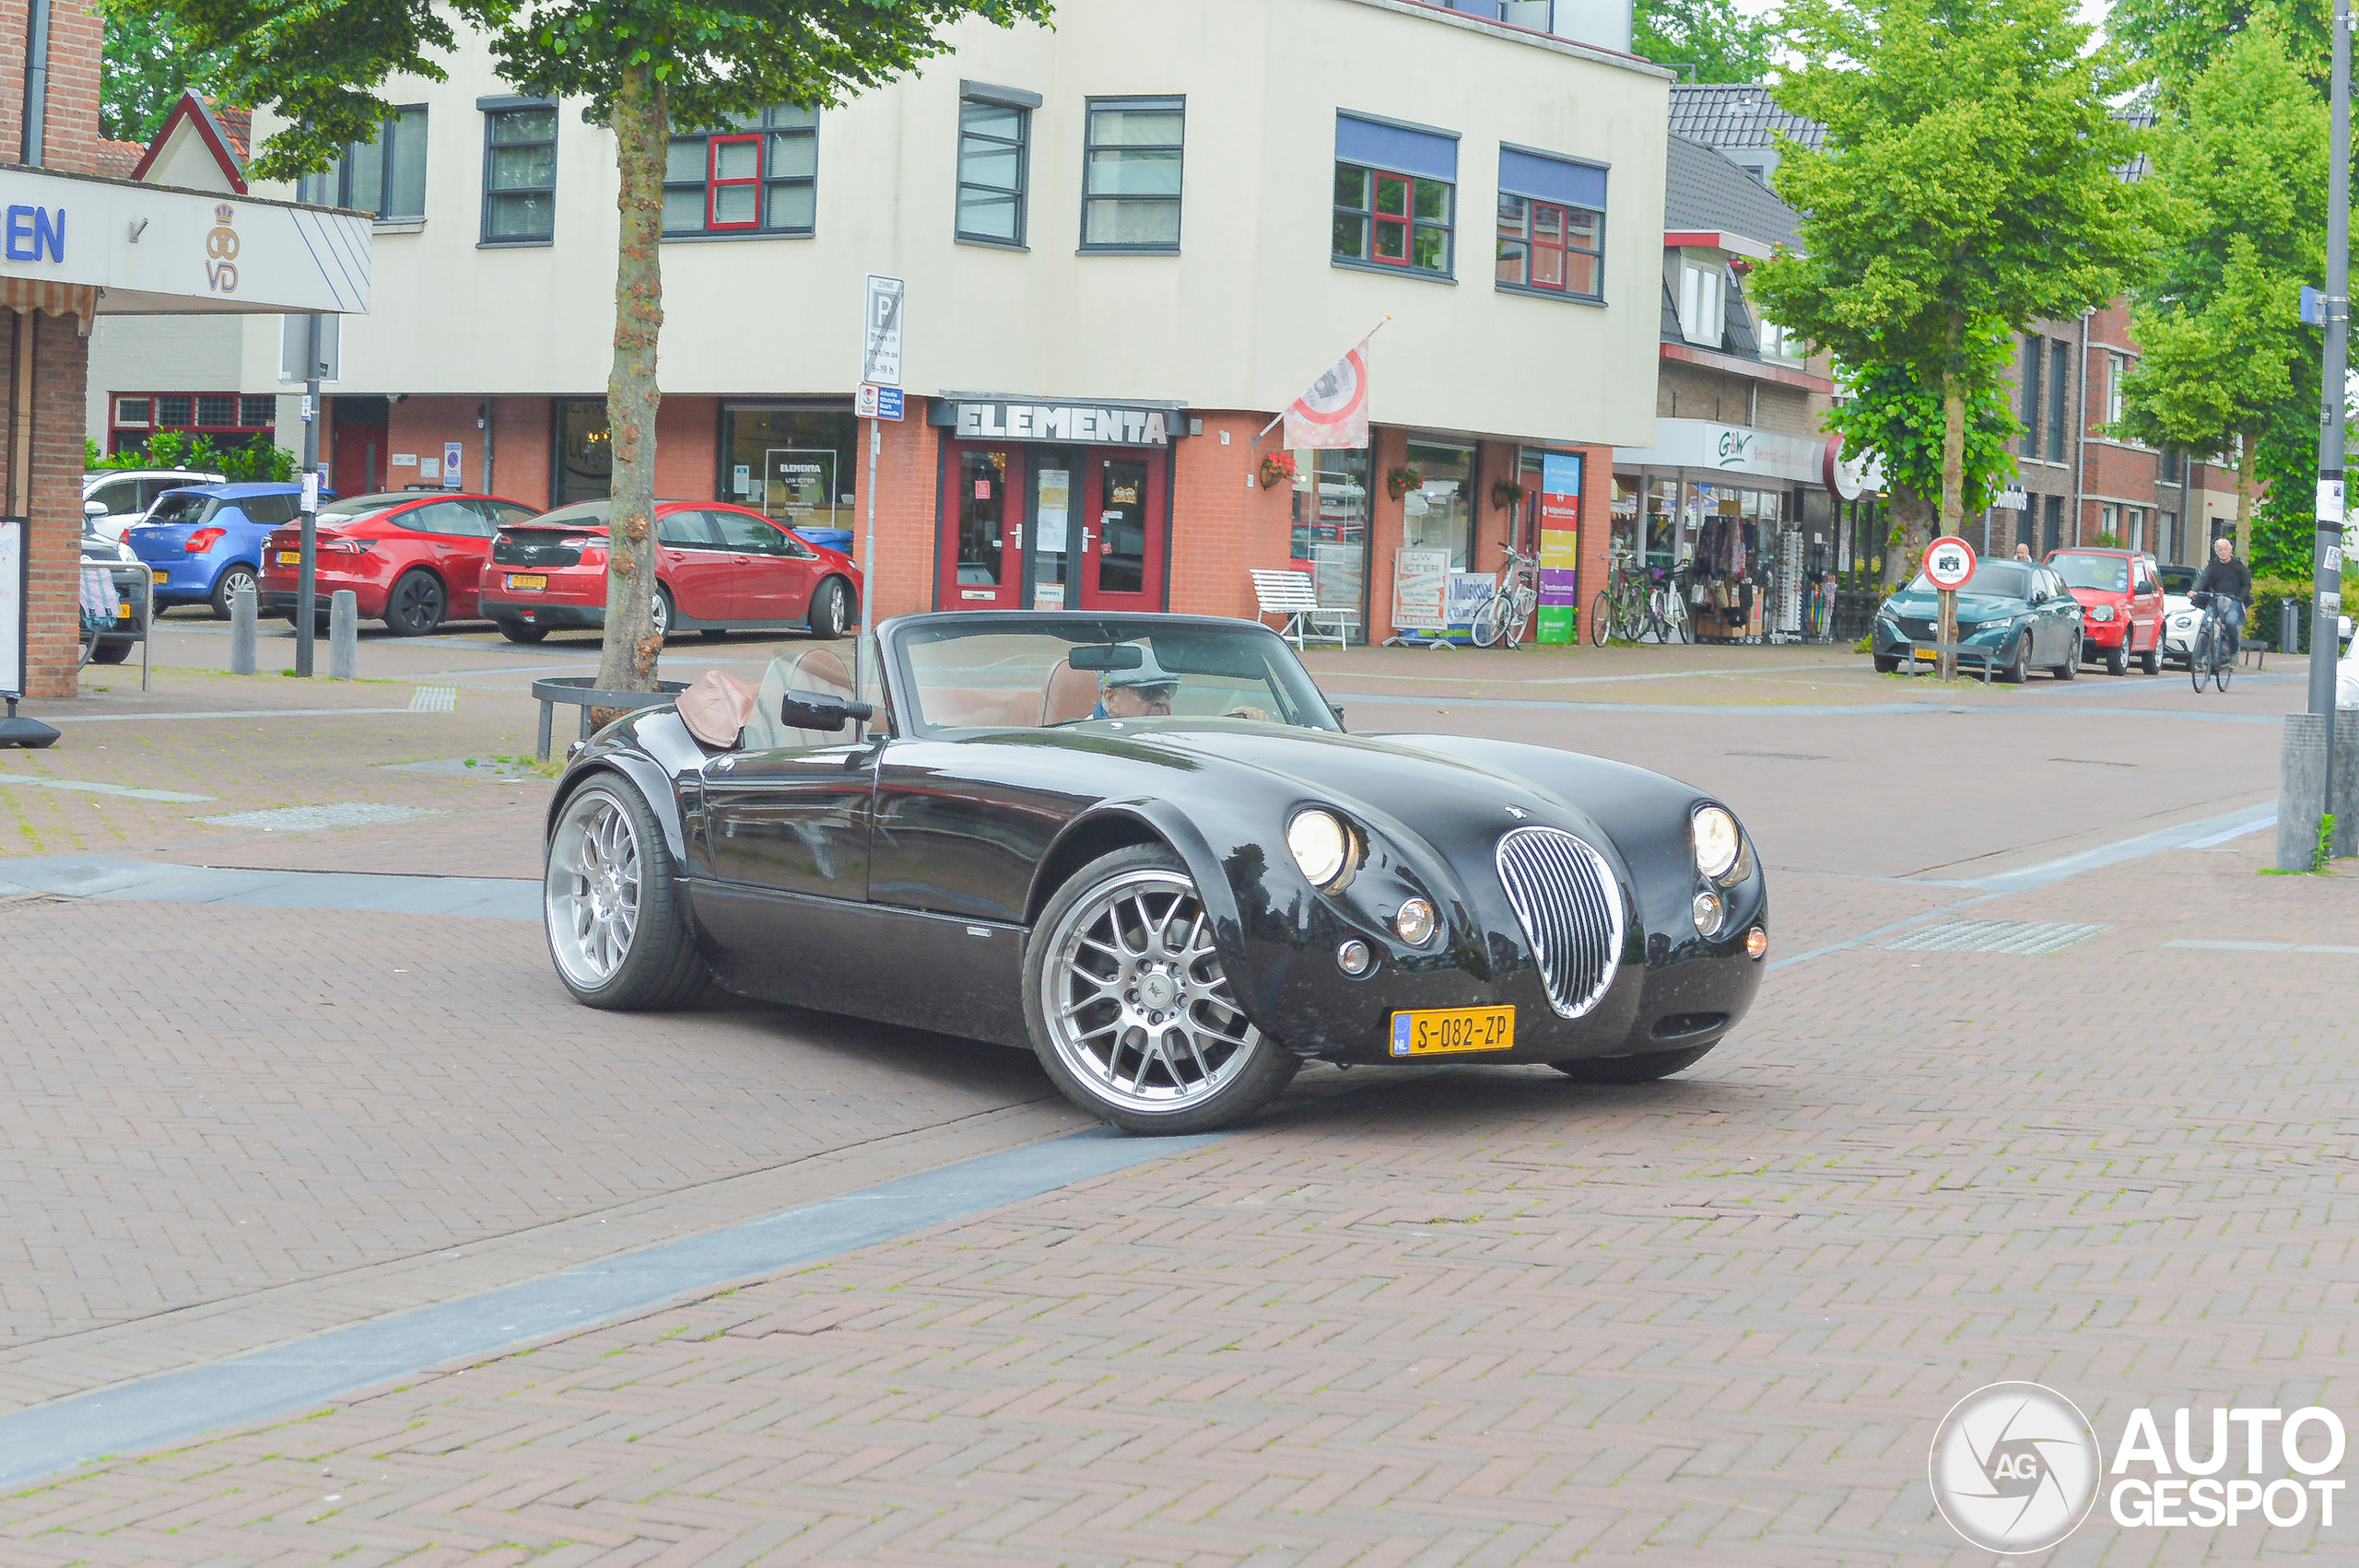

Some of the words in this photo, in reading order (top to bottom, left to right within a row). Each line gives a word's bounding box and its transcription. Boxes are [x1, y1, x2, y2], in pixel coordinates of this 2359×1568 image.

[0, 205, 65, 263] EN
[205, 259, 239, 293] VD
[877, 280, 894, 289] ZONE
[877, 295, 893, 326] P
[957, 404, 1168, 445] ELEMENTA
[1719, 430, 1754, 458] G&W
[780, 463, 822, 474] ELEMENTA
[1403, 564, 1439, 572] ICTER
[1411, 553, 1433, 561] UW
[1394, 1038, 1408, 1050] NL
[1417, 1015, 1507, 1048] S-082-ZP
